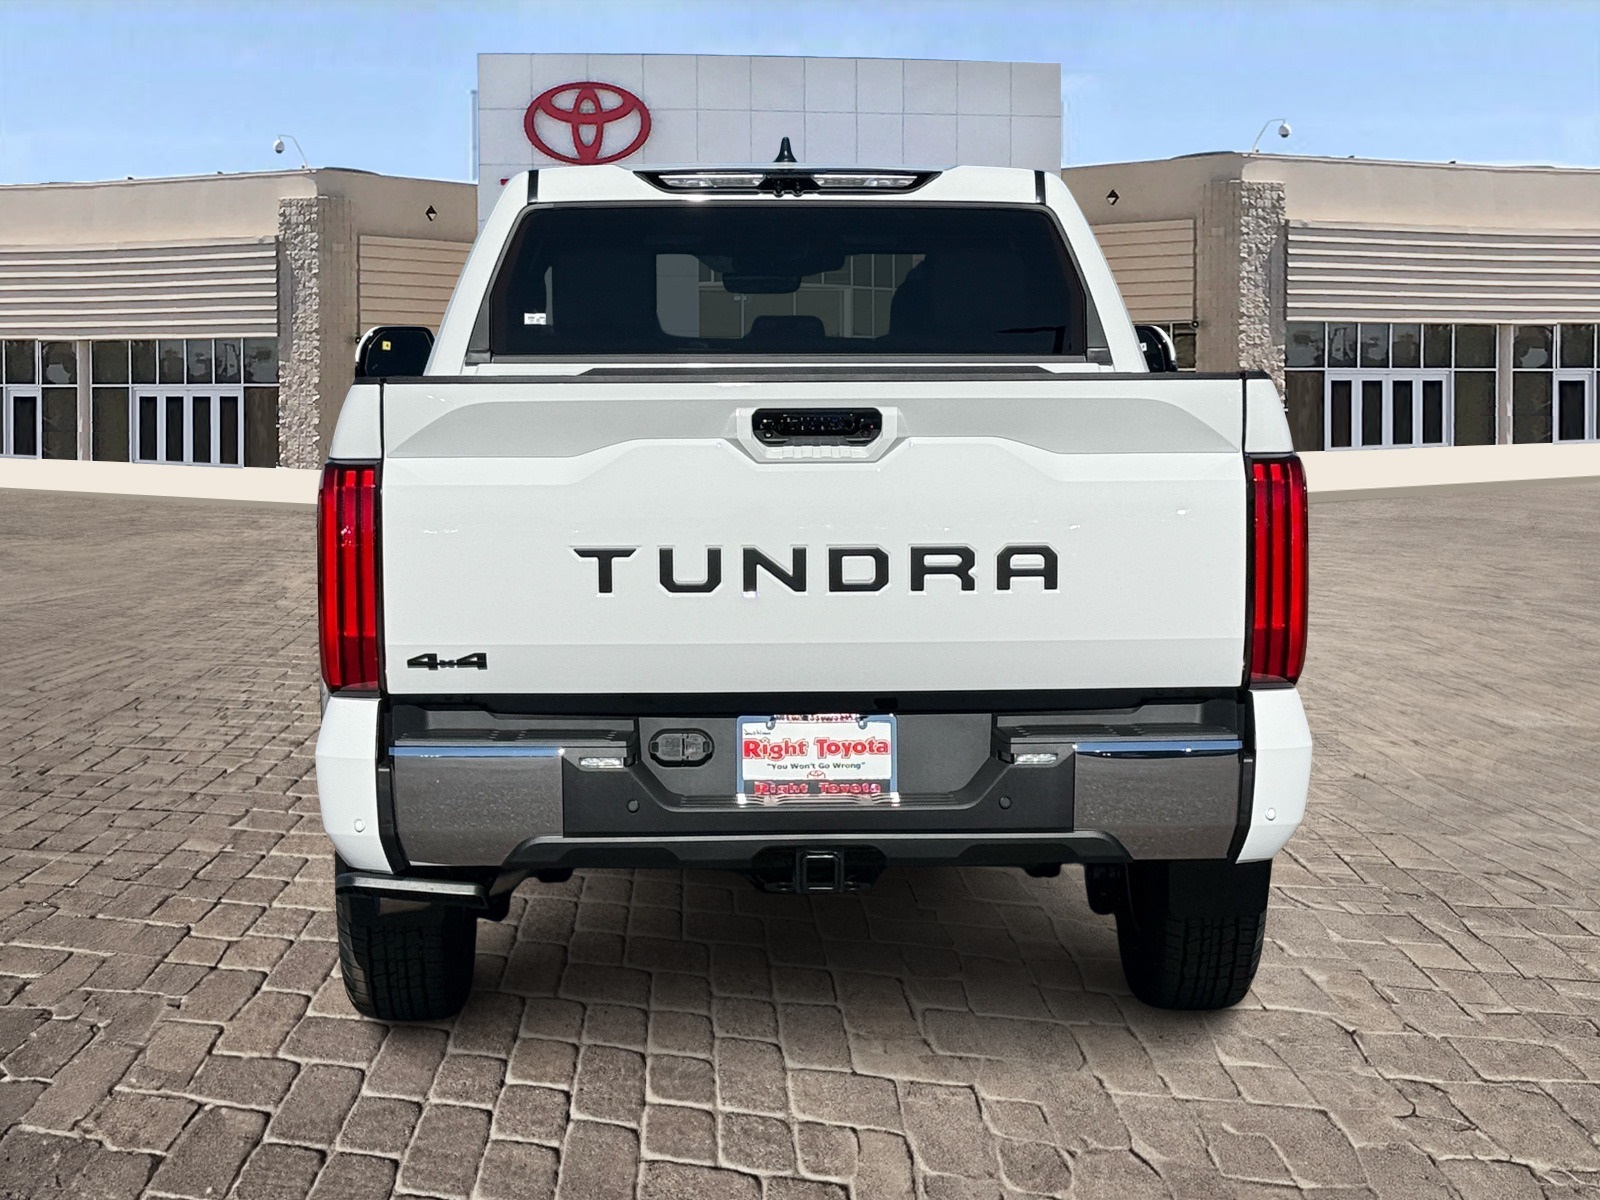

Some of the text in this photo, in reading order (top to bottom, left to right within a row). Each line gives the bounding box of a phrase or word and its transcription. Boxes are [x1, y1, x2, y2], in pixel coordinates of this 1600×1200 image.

[573, 545, 1058, 594] TUNDRA
[743, 737, 890, 760] Right Toyota
[755, 782, 881, 795] Right Toyota
